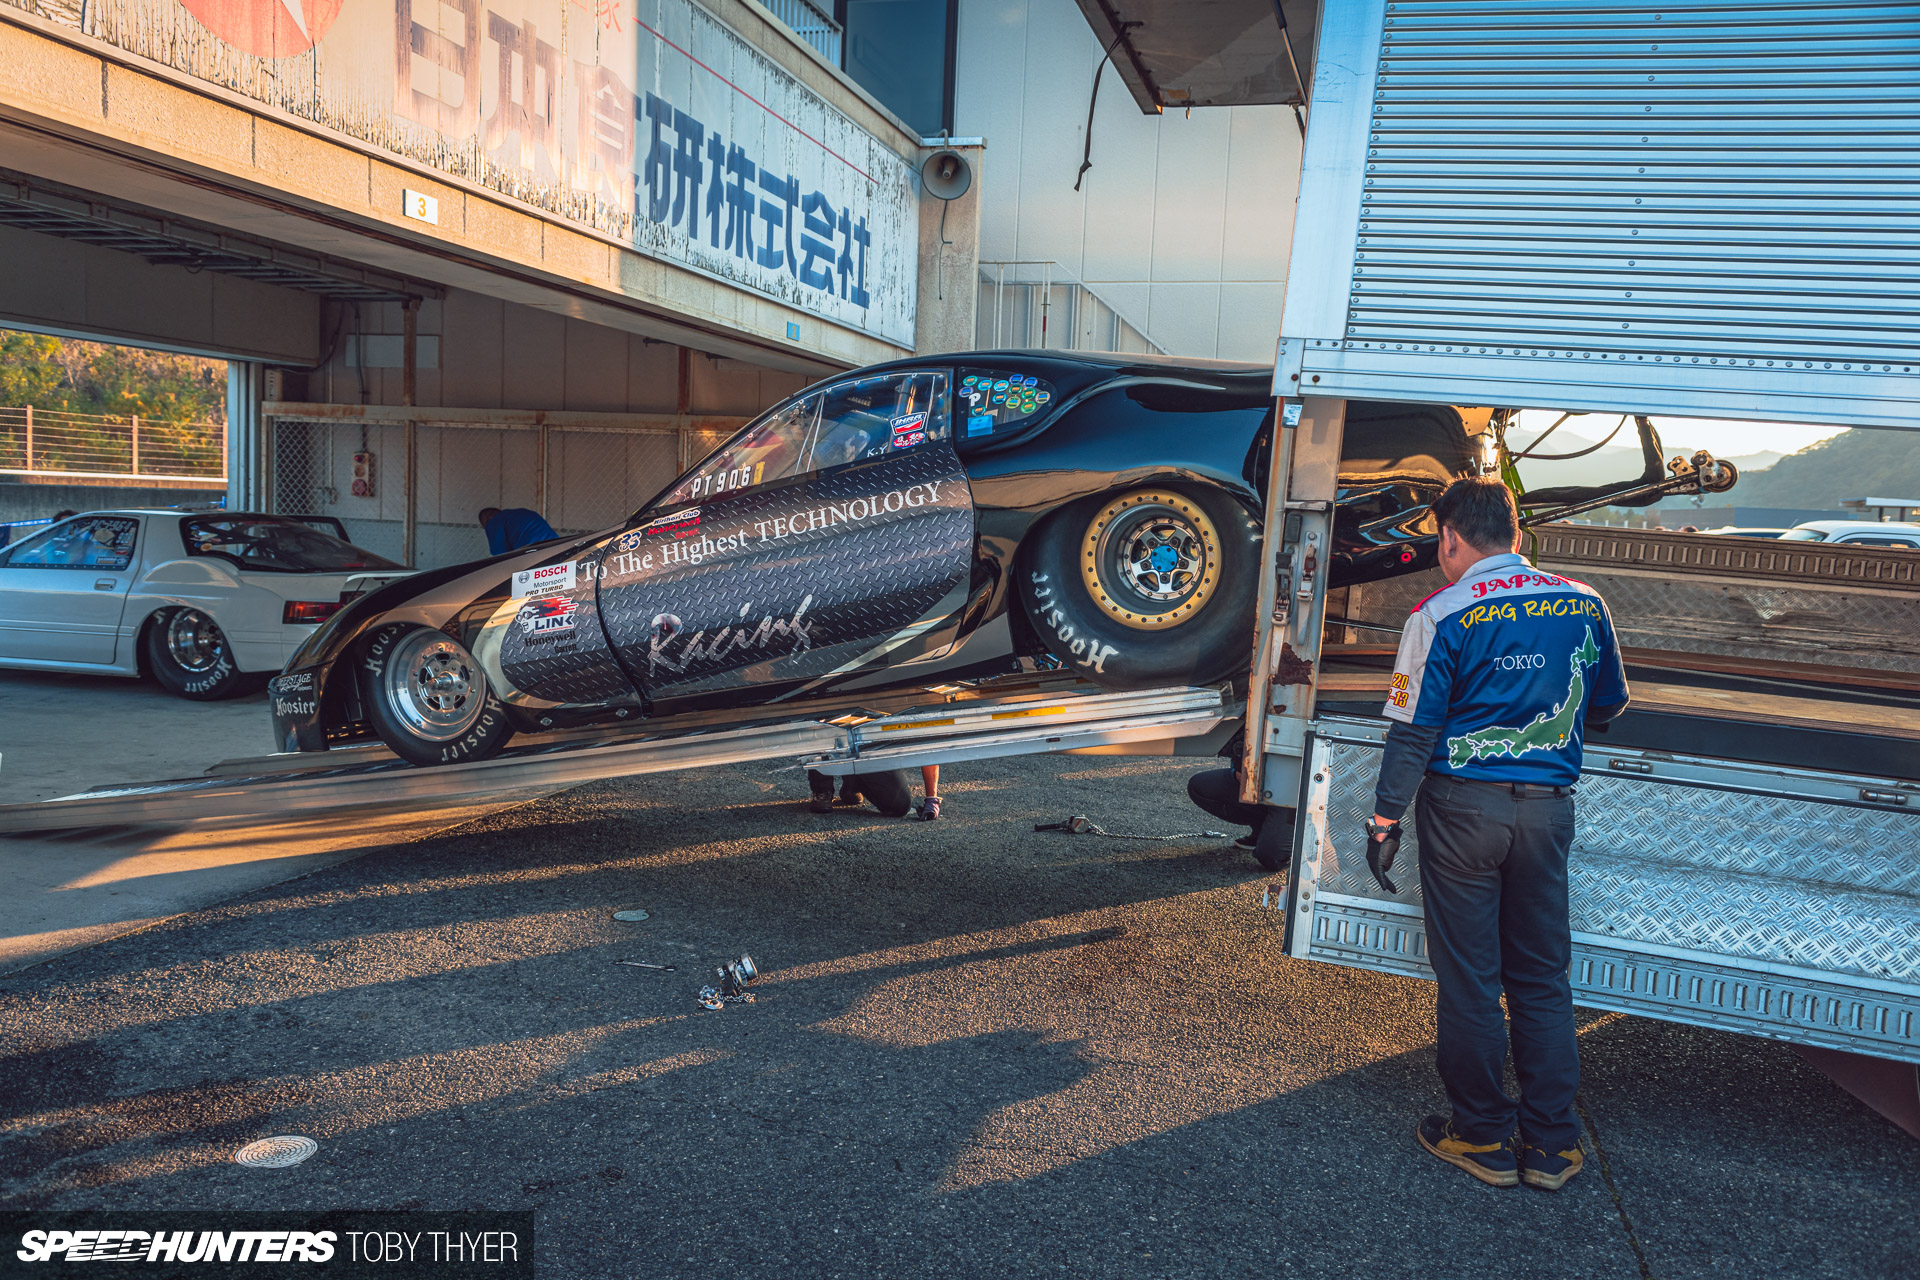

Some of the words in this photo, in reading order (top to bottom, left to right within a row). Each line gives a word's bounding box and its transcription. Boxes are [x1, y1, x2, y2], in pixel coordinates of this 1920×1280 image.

[417, 197, 426, 217] 3
[580, 560, 607, 581] To
[613, 551, 653, 575] The
[660, 528, 748, 565] Highest
[754, 481, 942, 543] TECHNOLOGY
[648, 517, 701, 536] Honeywell
[534, 565, 567, 579] BOSCH
[534, 577, 567, 588] Motorsport
[542, 585, 563, 593] TURBO
[535, 614, 573, 630] LINK
[1032, 571, 1119, 674] Hoosier
[1459, 602, 1516, 629] DRAG
[1523, 598, 1601, 621] RACING
[525, 631, 576, 647] Honeywell
[647, 594, 813, 677] Racing
[365, 623, 405, 677] Hoos
[1494, 654, 1545, 670] TOKYO
[1392, 672, 1409, 690] 20
[275, 696, 315, 717] Hoosier
[1387, 688, 1410, 708] -13
[441, 692, 501, 762] Hoosier
